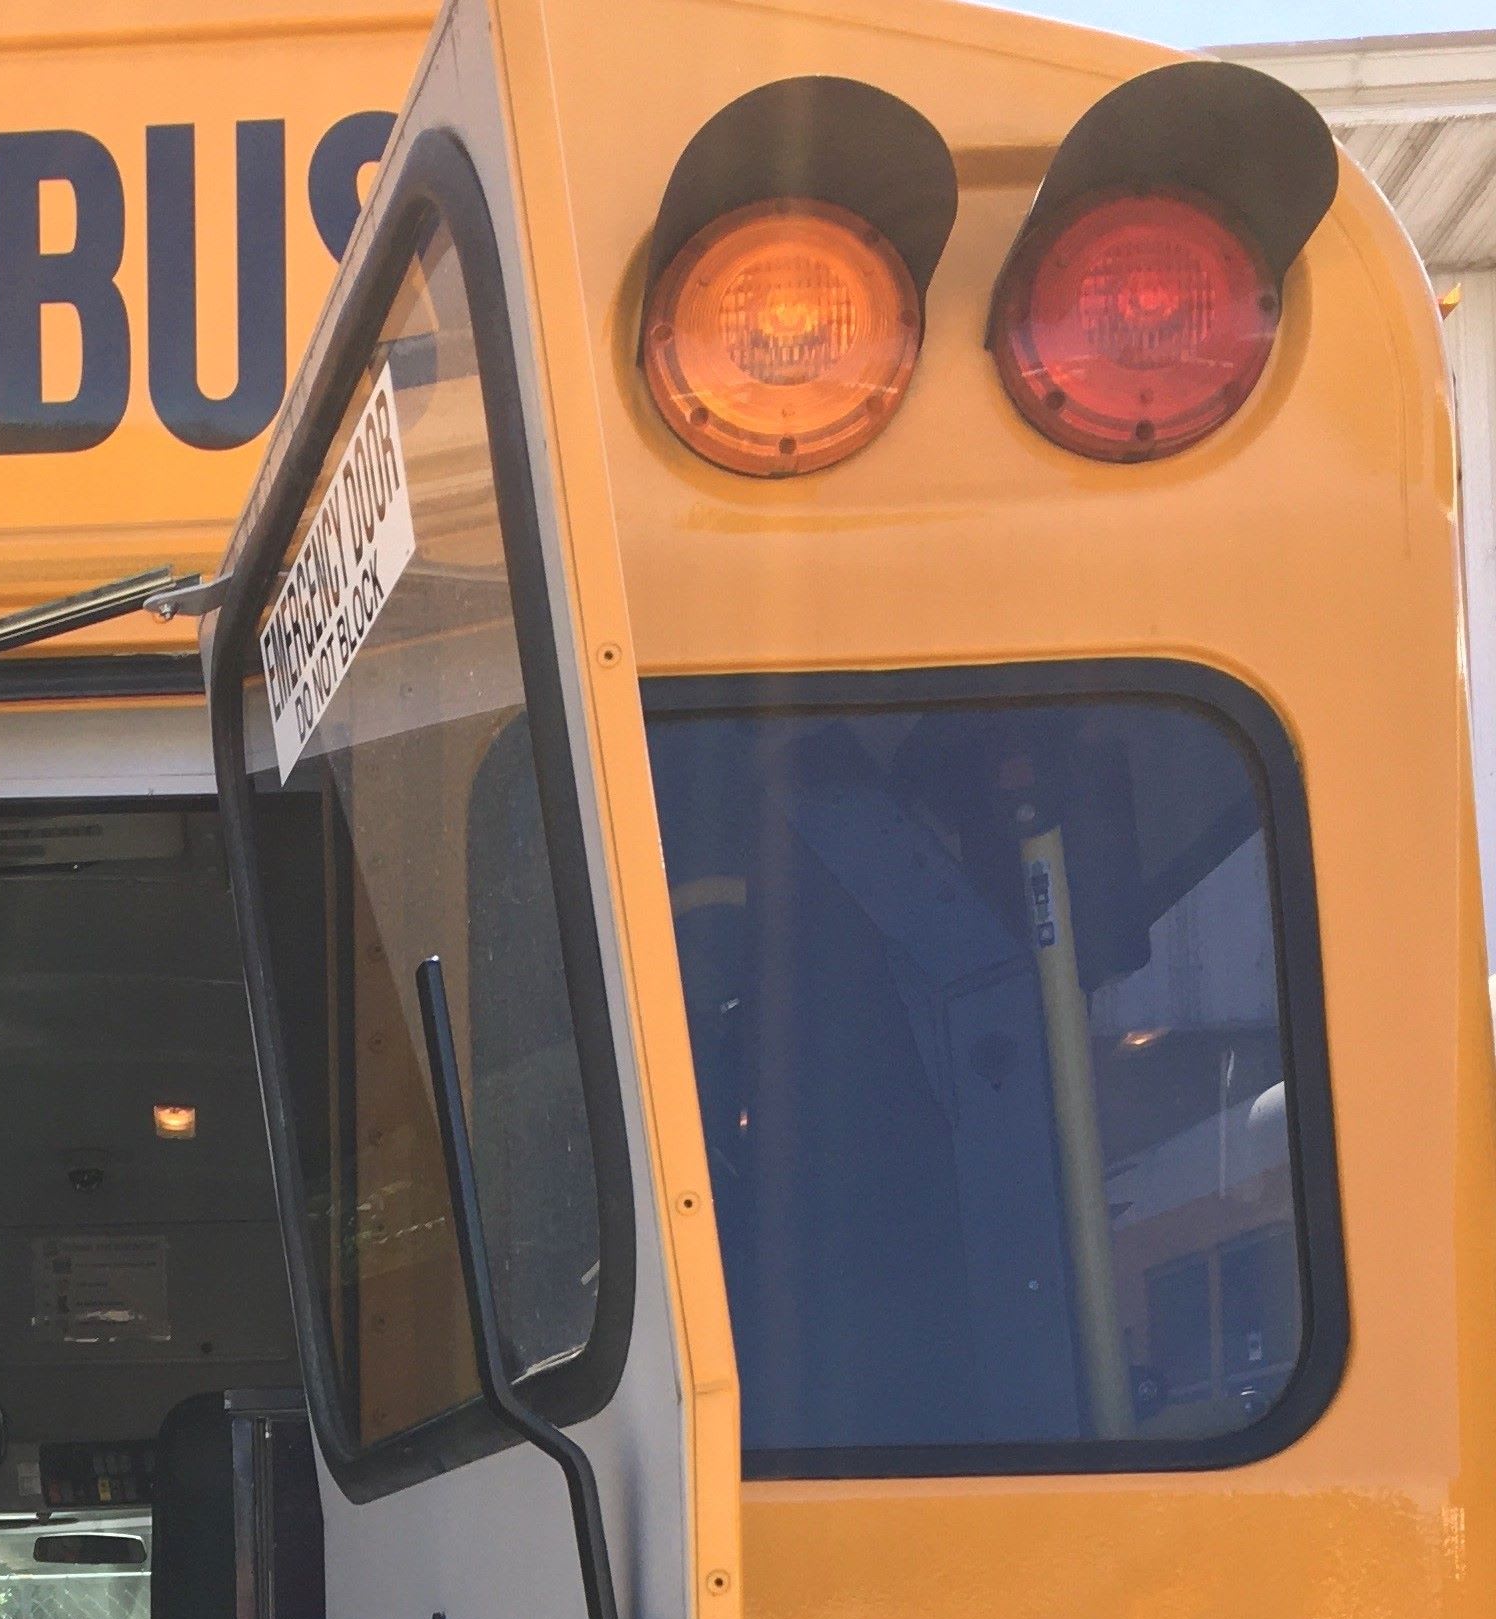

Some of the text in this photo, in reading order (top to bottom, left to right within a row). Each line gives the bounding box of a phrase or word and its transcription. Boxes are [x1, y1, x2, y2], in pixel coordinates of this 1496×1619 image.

[263, 388, 401, 723] EMERGENCY DOOR
[294, 548, 385, 744] DO NOT BLOCK
